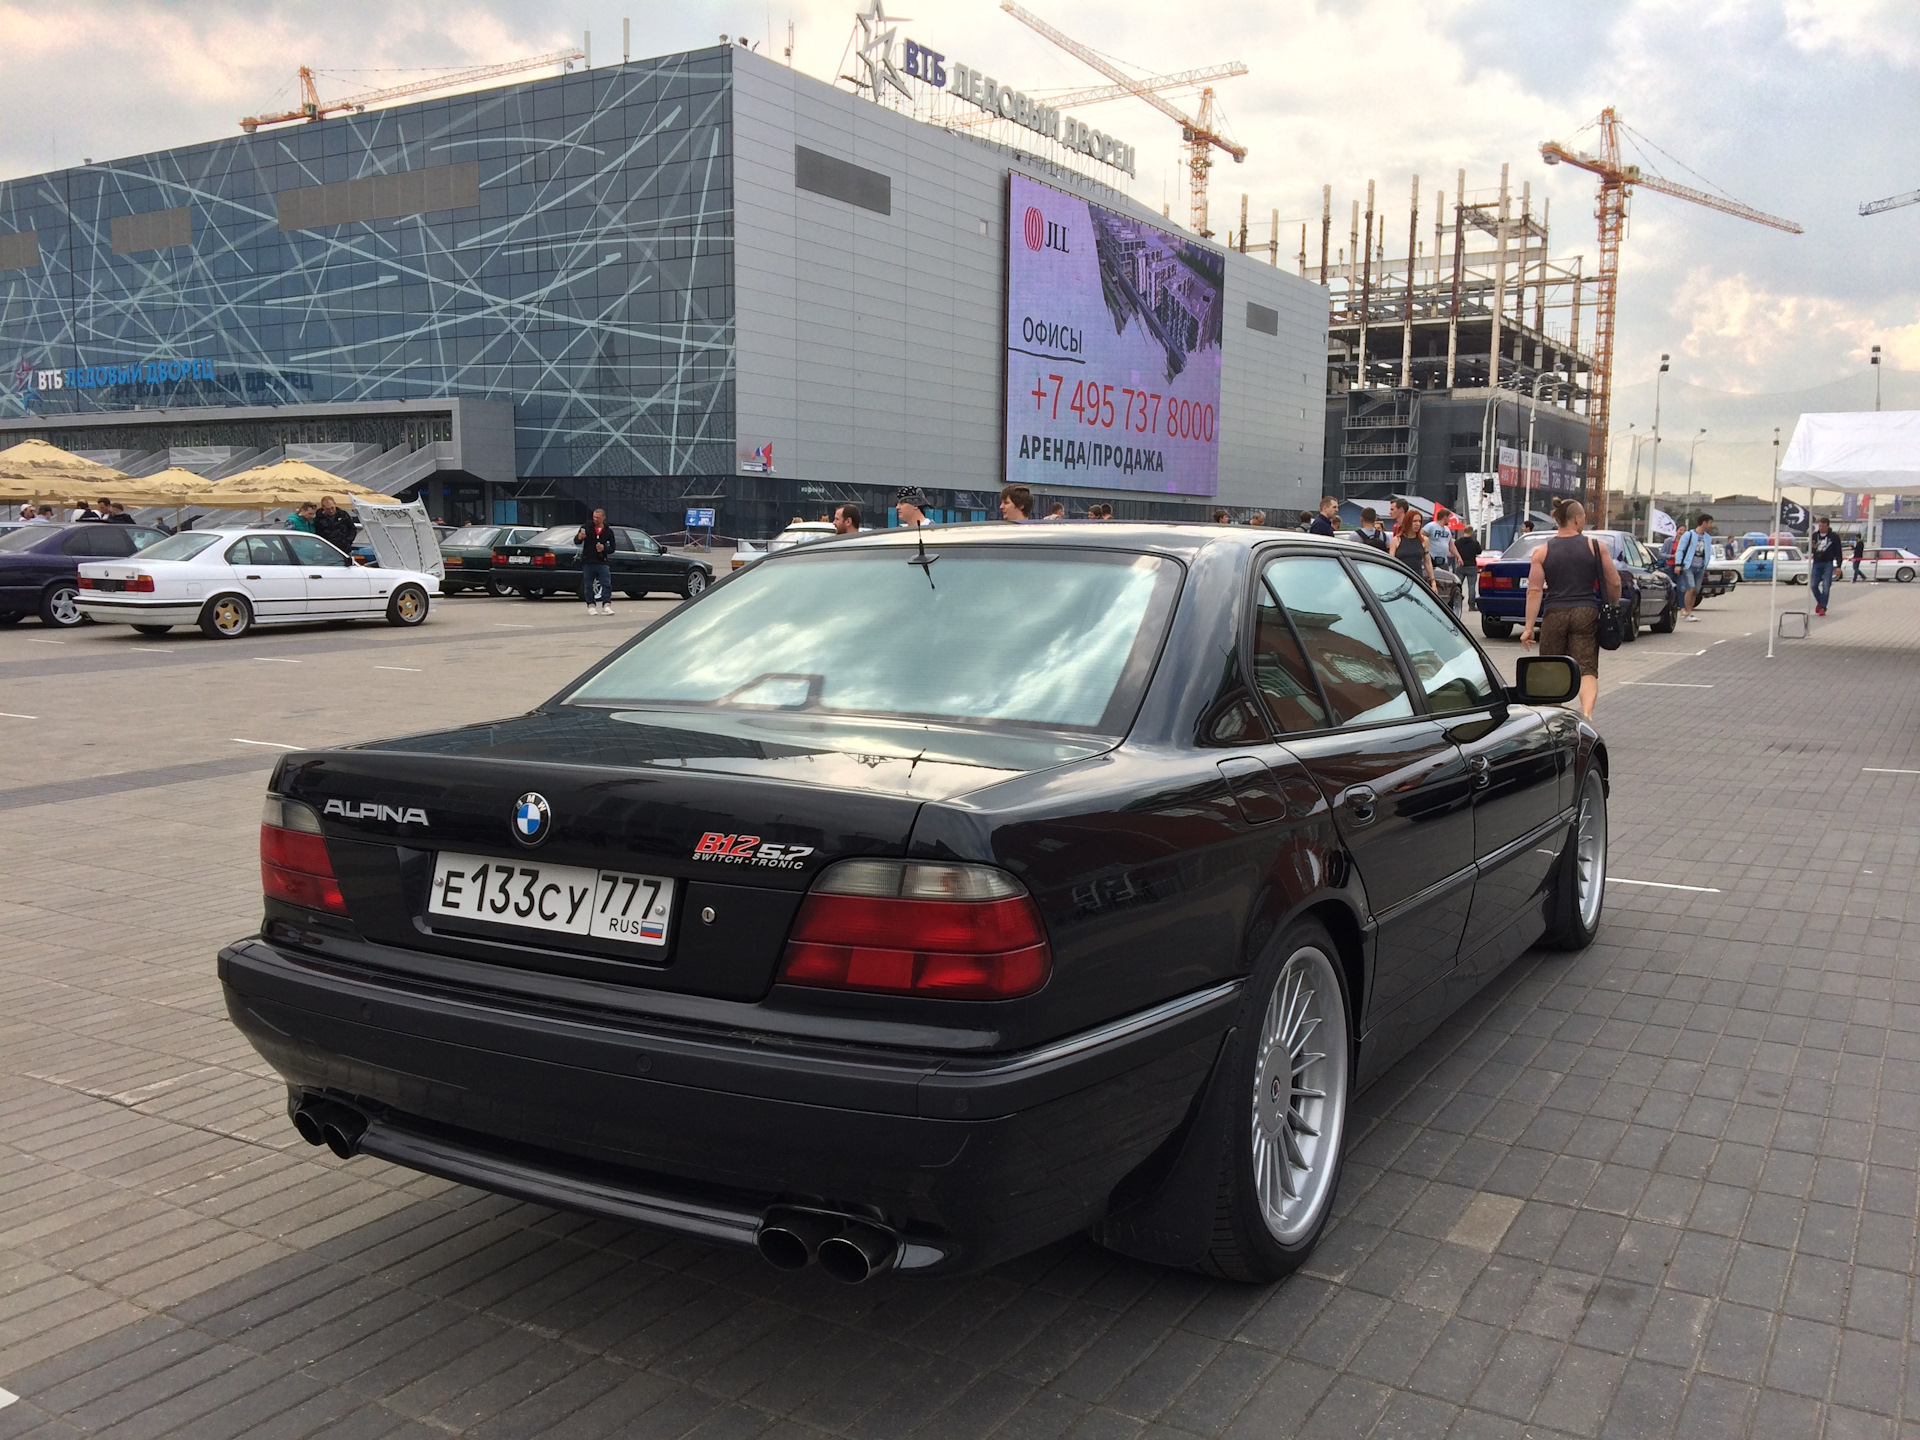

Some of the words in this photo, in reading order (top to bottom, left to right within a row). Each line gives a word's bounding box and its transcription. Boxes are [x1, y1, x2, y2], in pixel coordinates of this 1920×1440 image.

[903, 37, 946, 87] ВТБ
[951, 62, 1061, 141] ЛЕДОВЫЙ
[1062, 116, 1136, 180] ДВОРЕЦ
[1045, 221, 1070, 253] JLL
[1023, 316, 1082, 354] ОФИСЫ
[38, 369, 63, 391] ВТБ
[65, 360, 143, 389] ЛЕДОВЫЙ
[146, 358, 215, 385] ДВОРЕЦ
[1031, 374, 1063, 420] +7
[1070, 380, 1114, 428] 495
[1122, 388, 1161, 433] 737
[1167, 397, 1214, 442] 8000
[1019, 434, 1164, 475] АРЕНДА/ПРОДАЖА
[323, 799, 429, 826] ALPINA
[516, 794, 547, 812] BMW
[692, 852, 804, 869] SWITCH-TRONIC
[694, 832, 760, 857] B12
[756, 843, 815, 861] 5.7
[600, 874, 661, 920] 777
[609, 918, 639, 934] RUS
